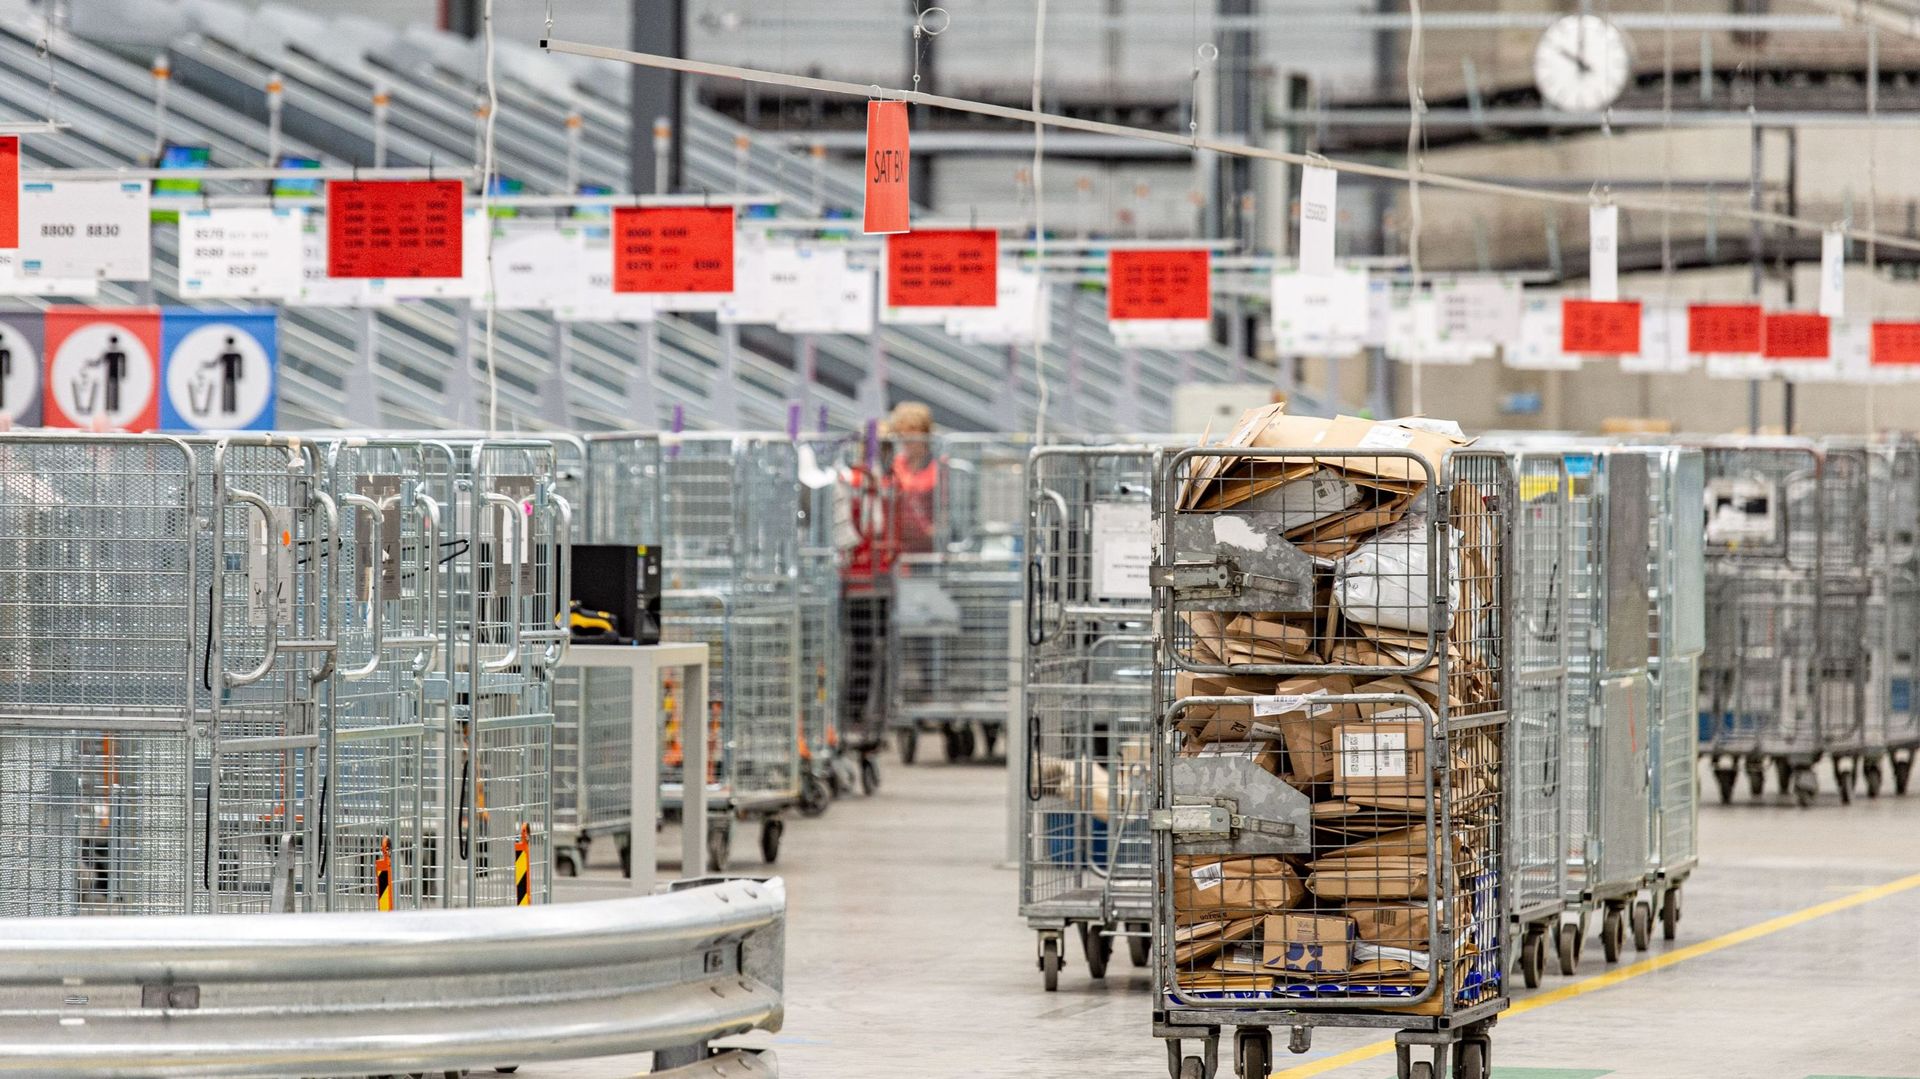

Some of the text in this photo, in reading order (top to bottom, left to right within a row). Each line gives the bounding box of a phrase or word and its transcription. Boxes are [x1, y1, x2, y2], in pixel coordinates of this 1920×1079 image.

[873, 149, 892, 184] SAT
[40, 224, 120, 237] 8800 8830
[1230, 721, 1247, 733] A2
